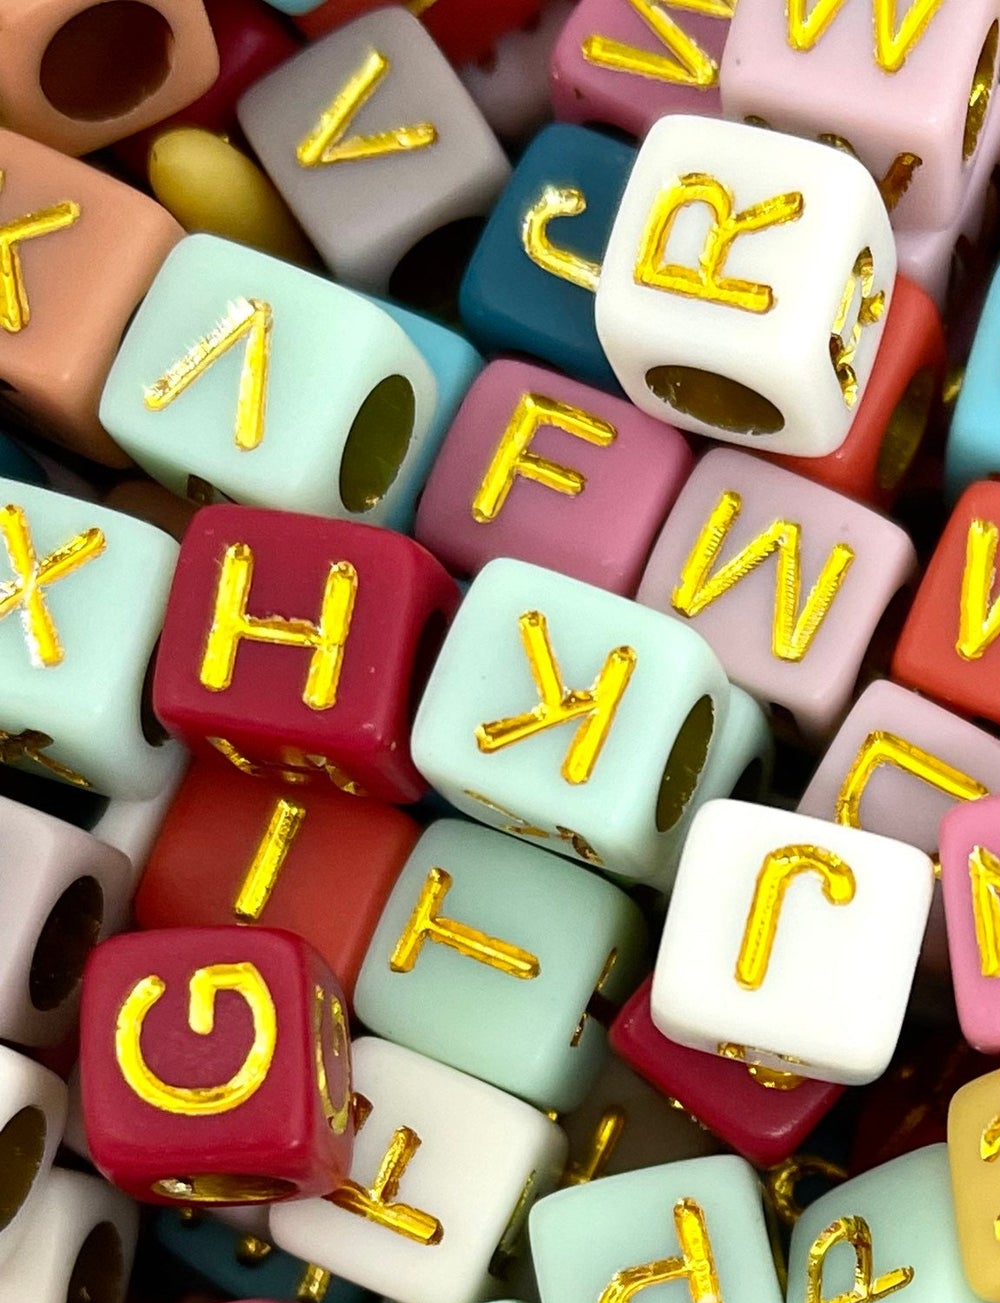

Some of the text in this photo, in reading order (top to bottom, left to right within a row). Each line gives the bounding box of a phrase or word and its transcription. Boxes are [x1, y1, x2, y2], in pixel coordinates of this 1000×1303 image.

[297, 47, 438, 168] V
[632, 172, 805, 315] R
[471, 391, 619, 524] F
[0, 497, 107, 669] X
[199, 542, 359, 711] H
[473, 610, 638, 786] K
[389, 866, 541, 981] T
[734, 843, 857, 991] J
[115, 961, 278, 1117] G
